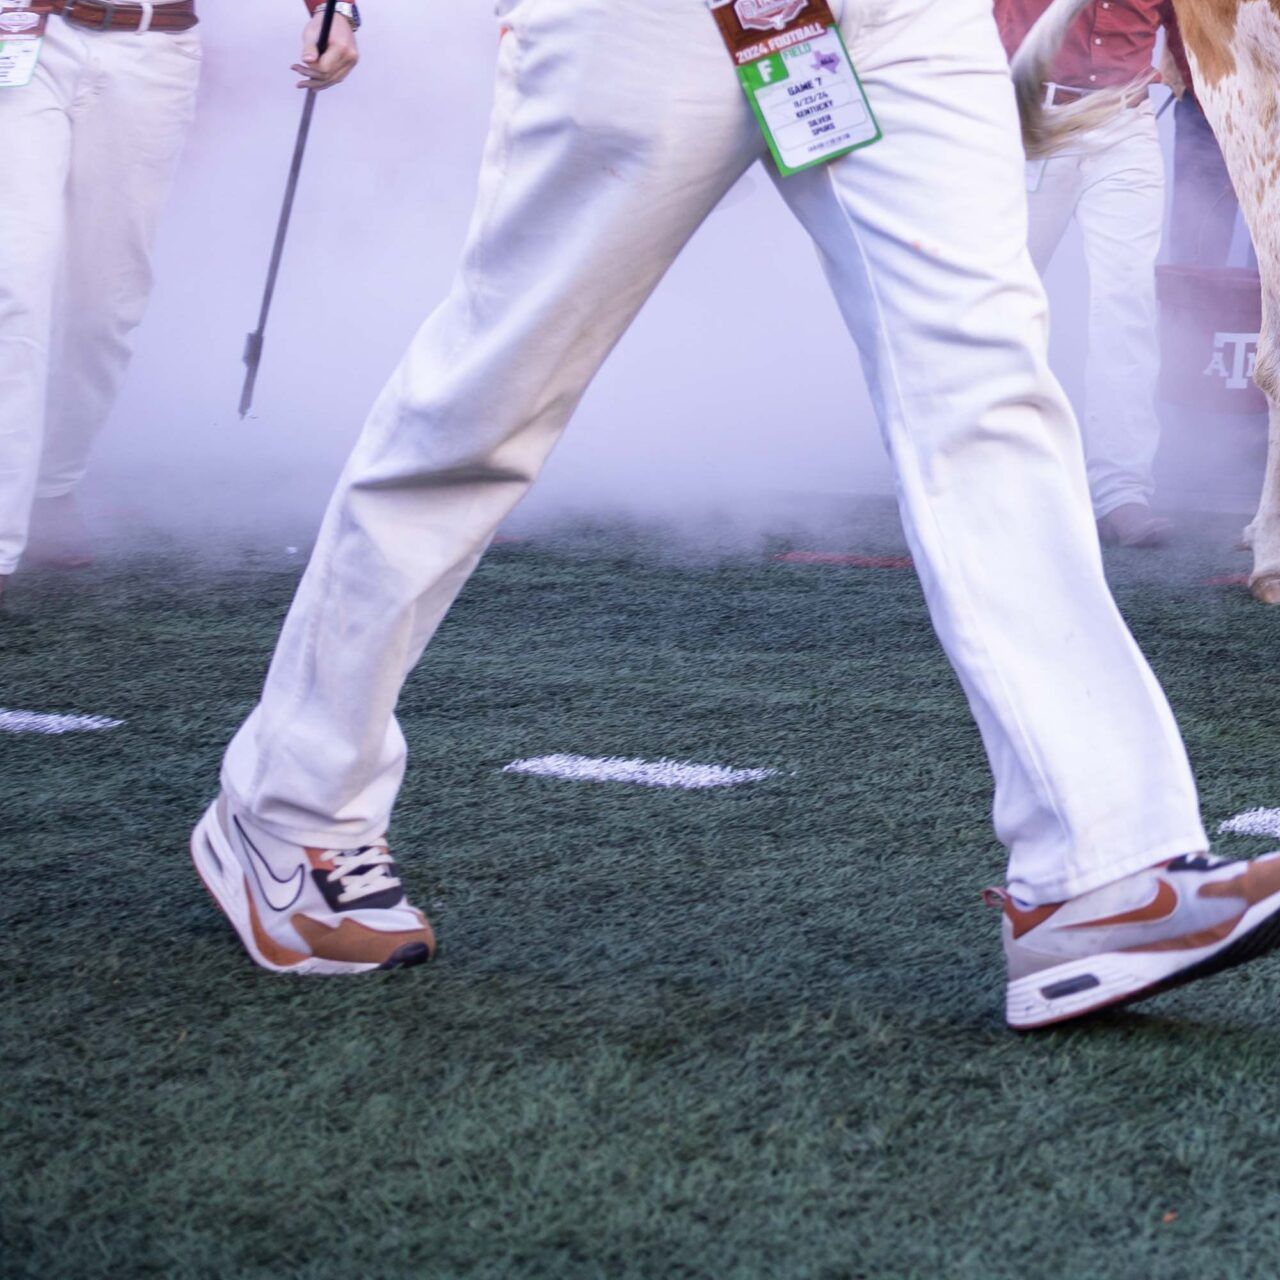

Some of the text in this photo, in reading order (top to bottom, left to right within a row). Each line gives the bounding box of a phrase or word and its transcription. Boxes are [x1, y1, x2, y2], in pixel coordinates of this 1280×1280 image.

[736, 22, 824, 63] 2024 FOOTBALL
[782, 42, 812, 60] FIELD
[756, 59, 775, 83] F
[787, 76, 823, 96] GAME 7
[795, 100, 833, 118] KENTUCKY
